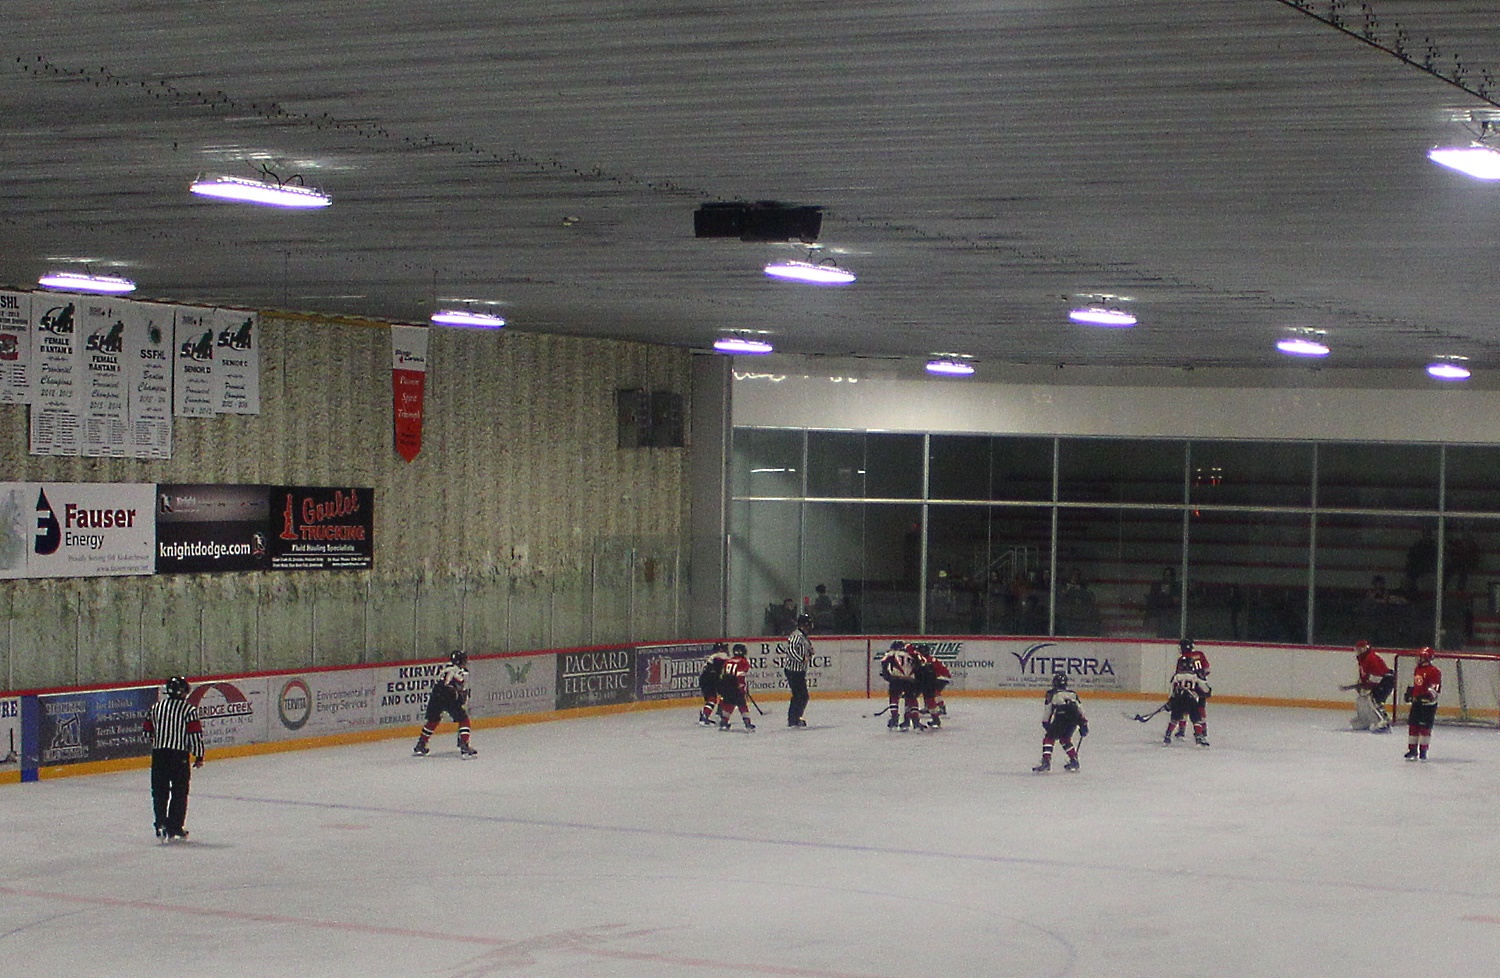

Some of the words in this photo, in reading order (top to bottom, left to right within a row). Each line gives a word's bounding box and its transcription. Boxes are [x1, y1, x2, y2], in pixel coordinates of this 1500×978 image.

[44, 337, 70, 346] FEMALE
[92, 355, 118, 364] FEMALE
[302, 489, 360, 524] Goulet
[65, 503, 136, 528] Fauser
[65, 531, 105, 549] Energy
[300, 525, 366, 541] TRUCKING
[160, 541, 251, 560] knightdodge.com
[761, 643, 770, 655] B
[565, 651, 629, 673] PACKARD
[749, 657, 767, 669] RE
[773, 656, 832, 669] SEICE
[946, 660, 994, 668] STRUCTION
[1011, 643, 1115, 676] VITERRA
[399, 666, 443, 679] KIRWA
[660, 656, 705, 684] Dynam
[565, 673, 629, 694] ELECTRIC
[671, 676, 700, 689] DISPO
[316, 687, 363, 701] Environmental
[381, 695, 401, 707] AND
[0, 700, 18, 717] RE
[199, 704, 225, 716] BRIDGE
[227, 702, 253, 713] creek
[316, 702, 339, 714] Energy
[340, 700, 368, 711] Services
